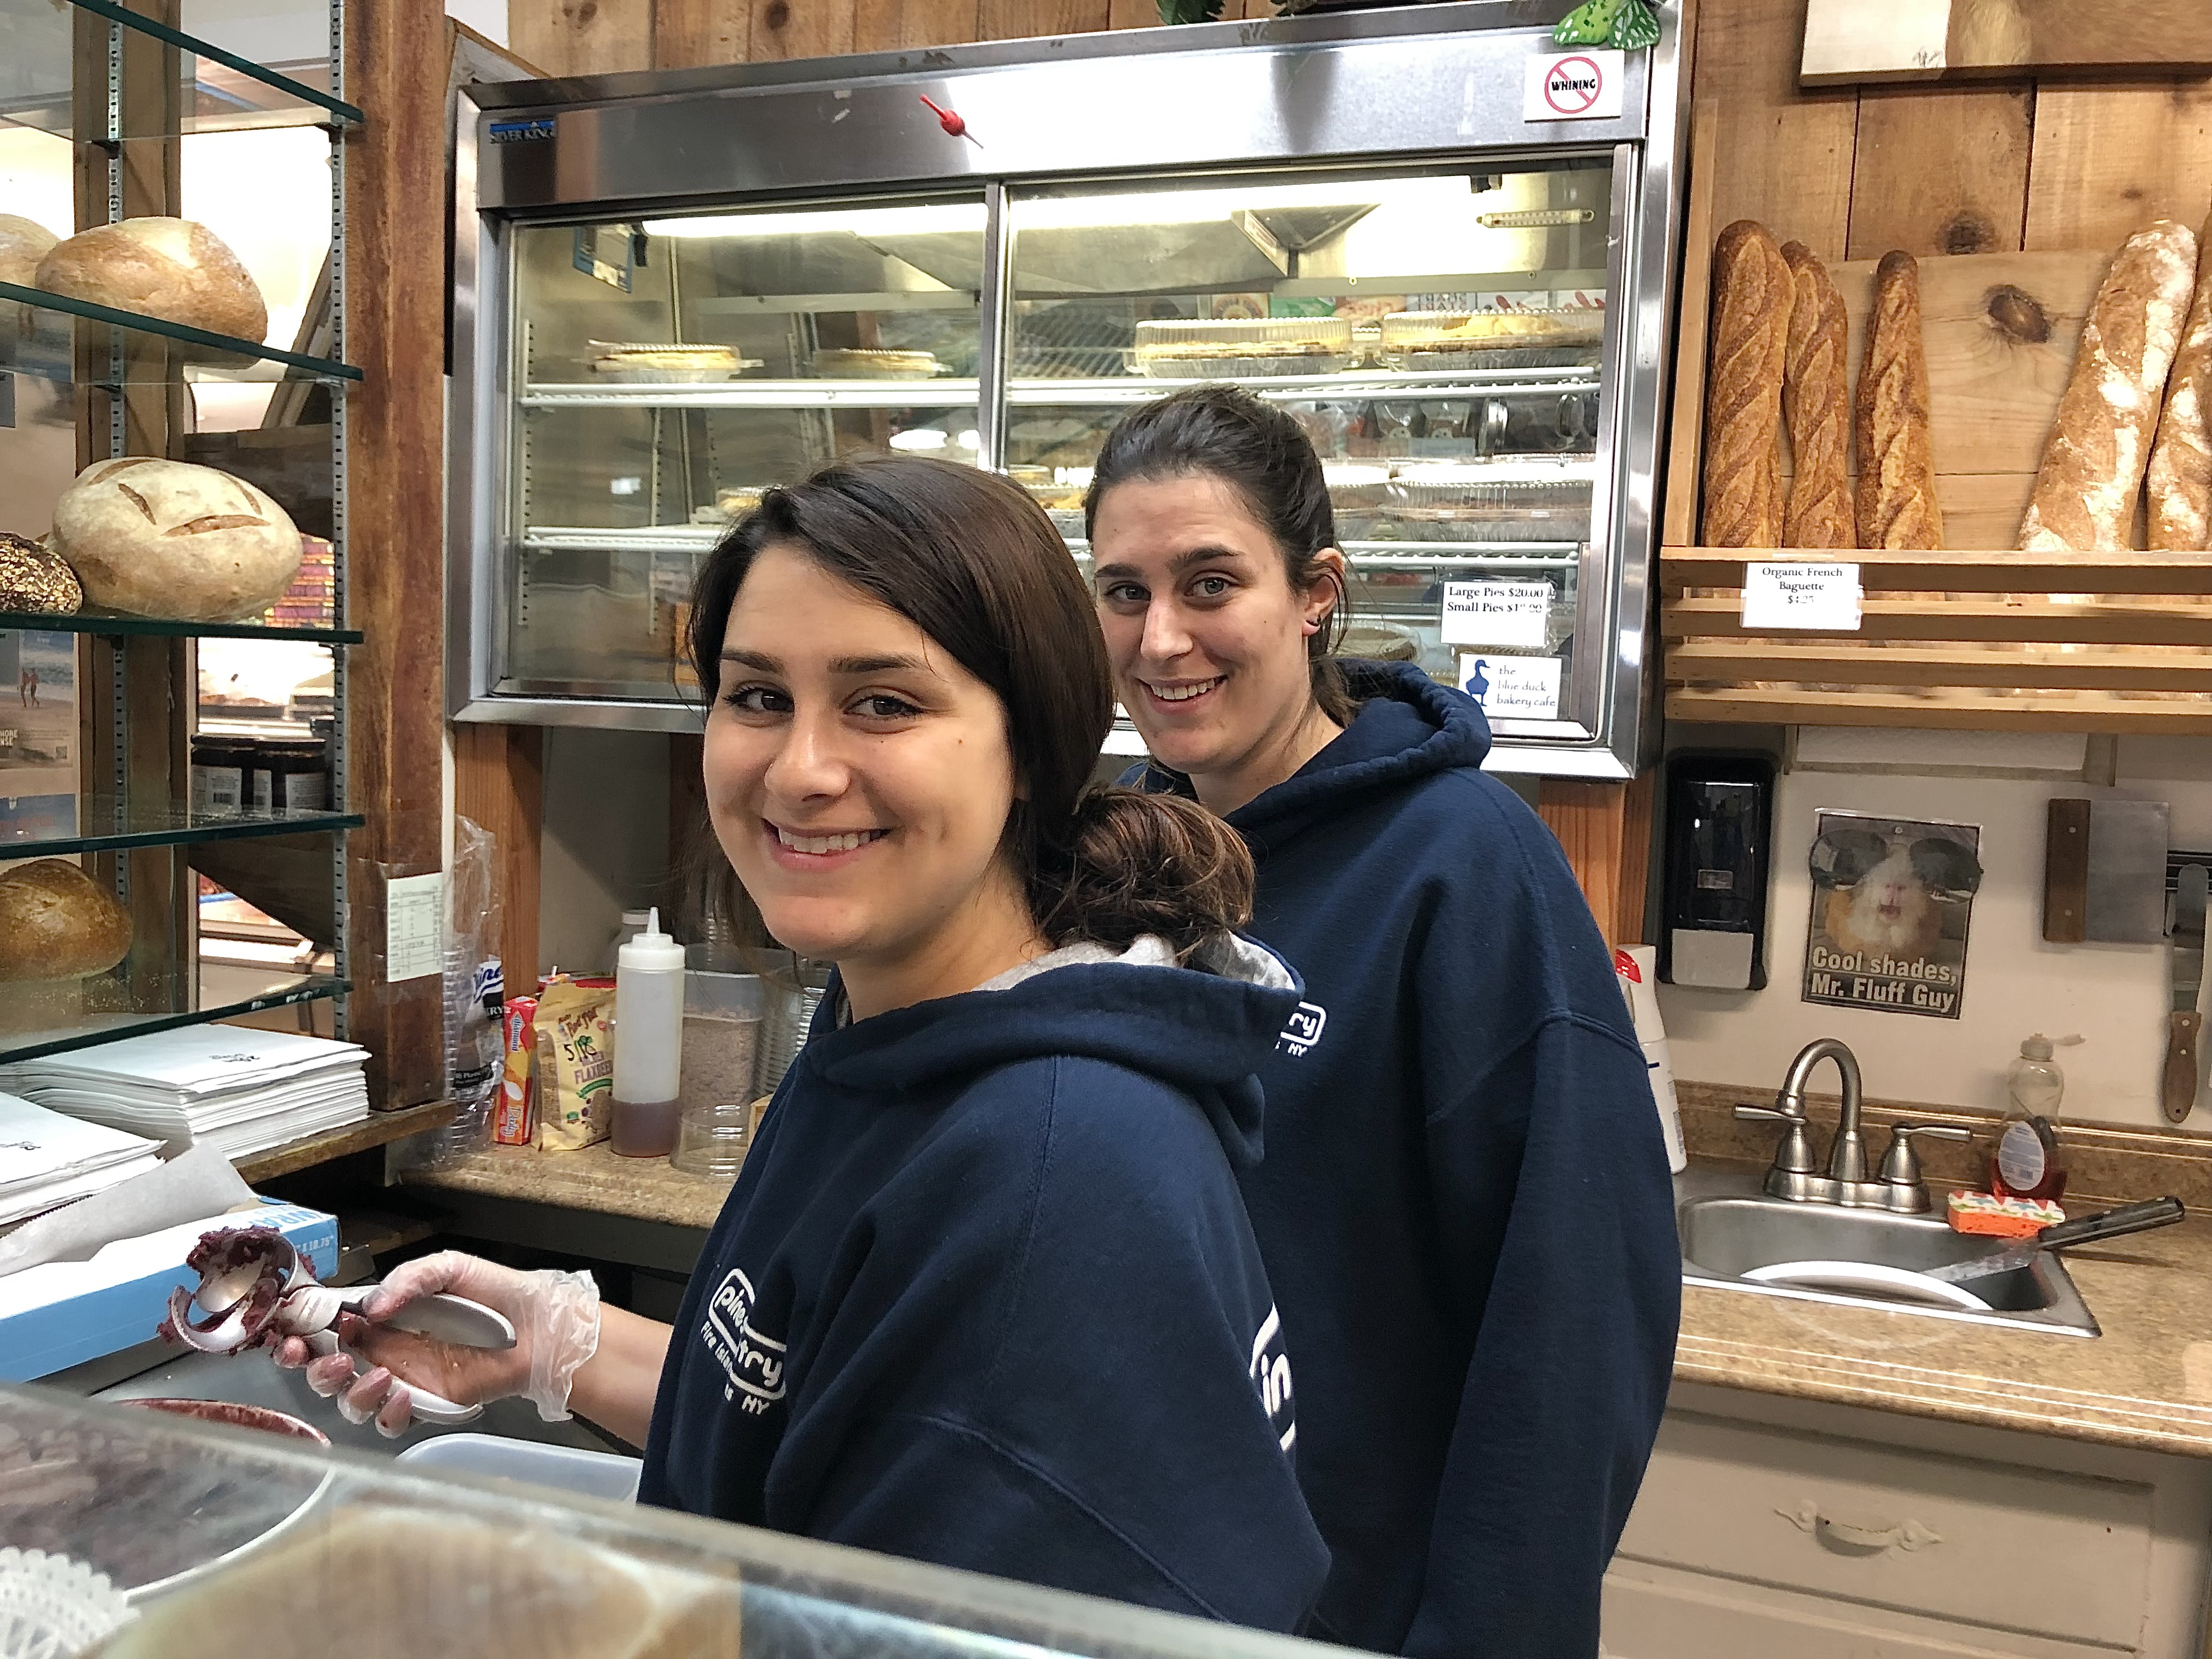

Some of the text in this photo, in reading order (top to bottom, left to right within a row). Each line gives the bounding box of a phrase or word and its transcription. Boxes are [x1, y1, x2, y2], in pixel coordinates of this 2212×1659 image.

[1551, 78, 1596, 92] WHINING
[1762, 567, 1842, 579] Organic French
[1449, 587, 1543, 599] Large Pies $20.00
[1779, 581, 1824, 593] Baguette
[1447, 602, 1479, 612] Small
[1482, 603, 1503, 612] Pies
[1499, 665, 1516, 675] the
[1498, 680, 1546, 692] blue duck
[1497, 693, 1555, 709] bakery cafe
[1812, 946, 1957, 986] Cool shades,
[1811, 973, 1955, 1013] Mr. Fluff Guy
[1289, 1013, 1317, 1037] ry
[1288, 1043, 1307, 1058] NY
[714, 1285, 747, 1334] pine
[737, 1339, 783, 1388] try
[742, 1394, 770, 1415] NY
